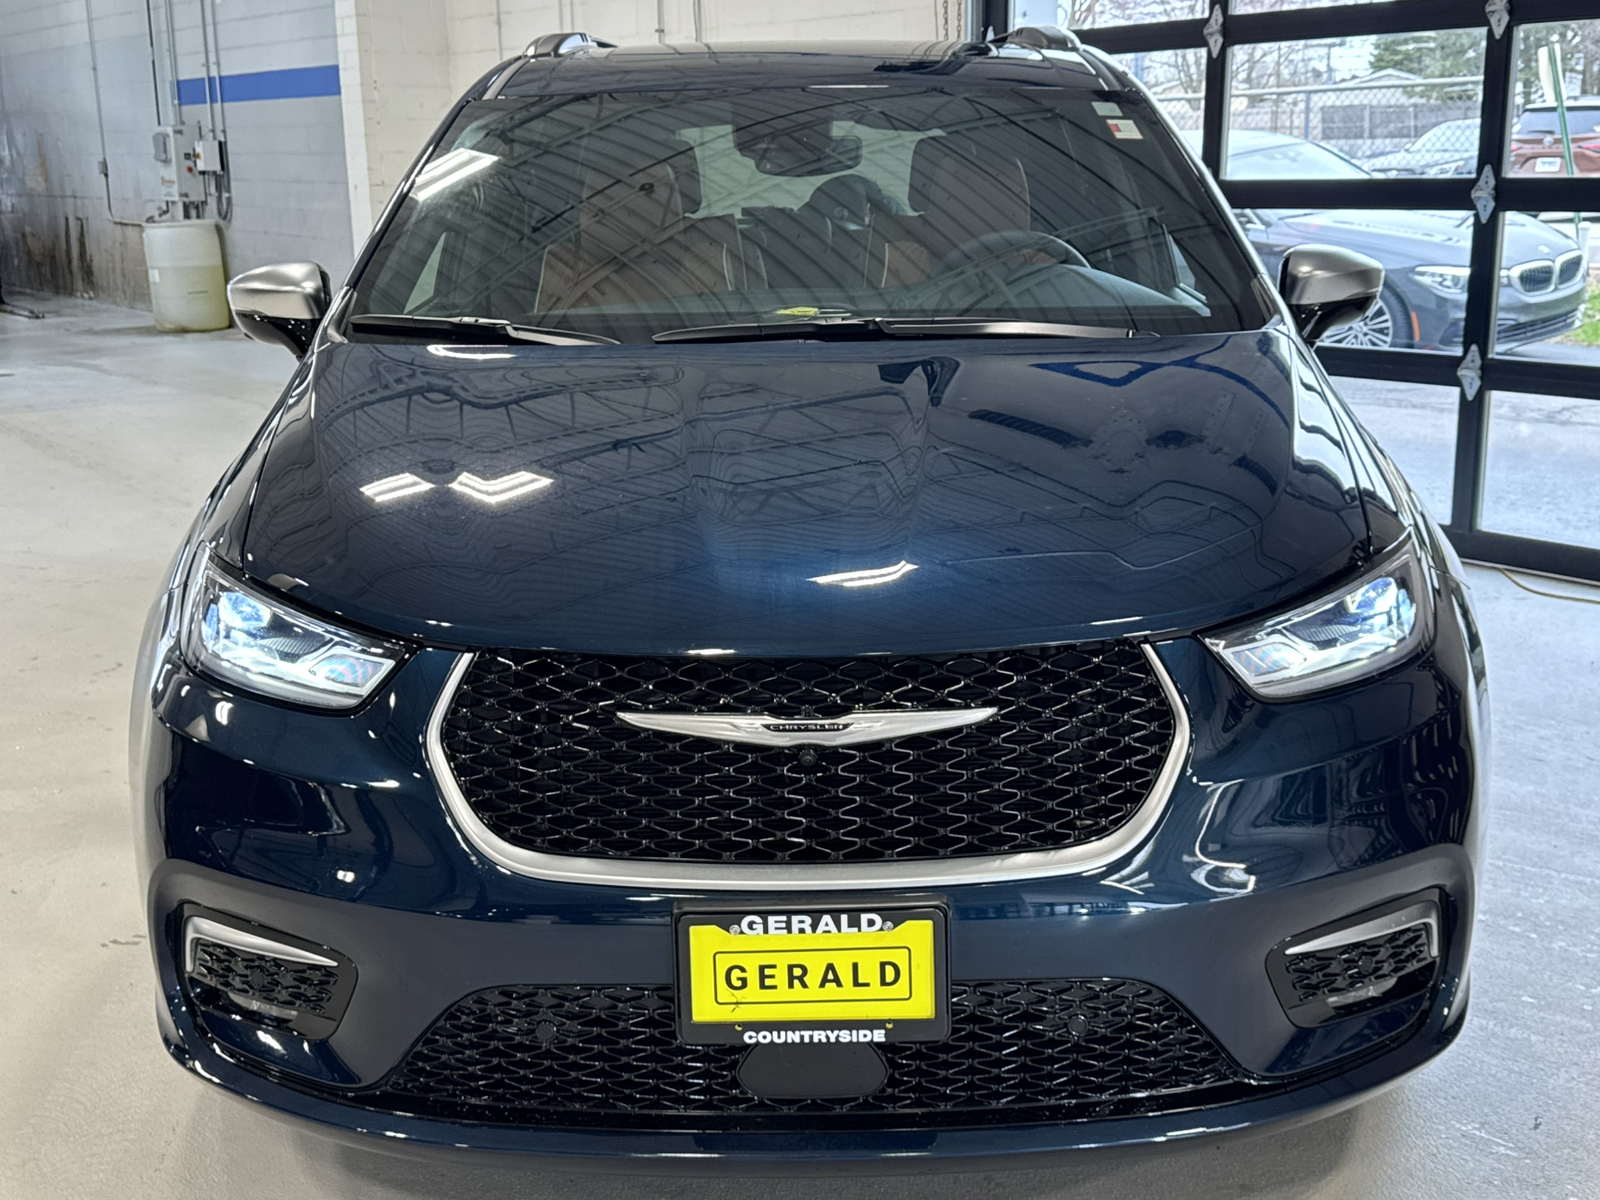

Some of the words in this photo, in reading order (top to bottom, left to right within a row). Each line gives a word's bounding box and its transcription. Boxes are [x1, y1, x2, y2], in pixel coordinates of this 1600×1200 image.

[740, 913, 883, 935] GERALD
[724, 960, 901, 991] GERALD
[743, 1029, 886, 1044] COUNTRYSIDE
